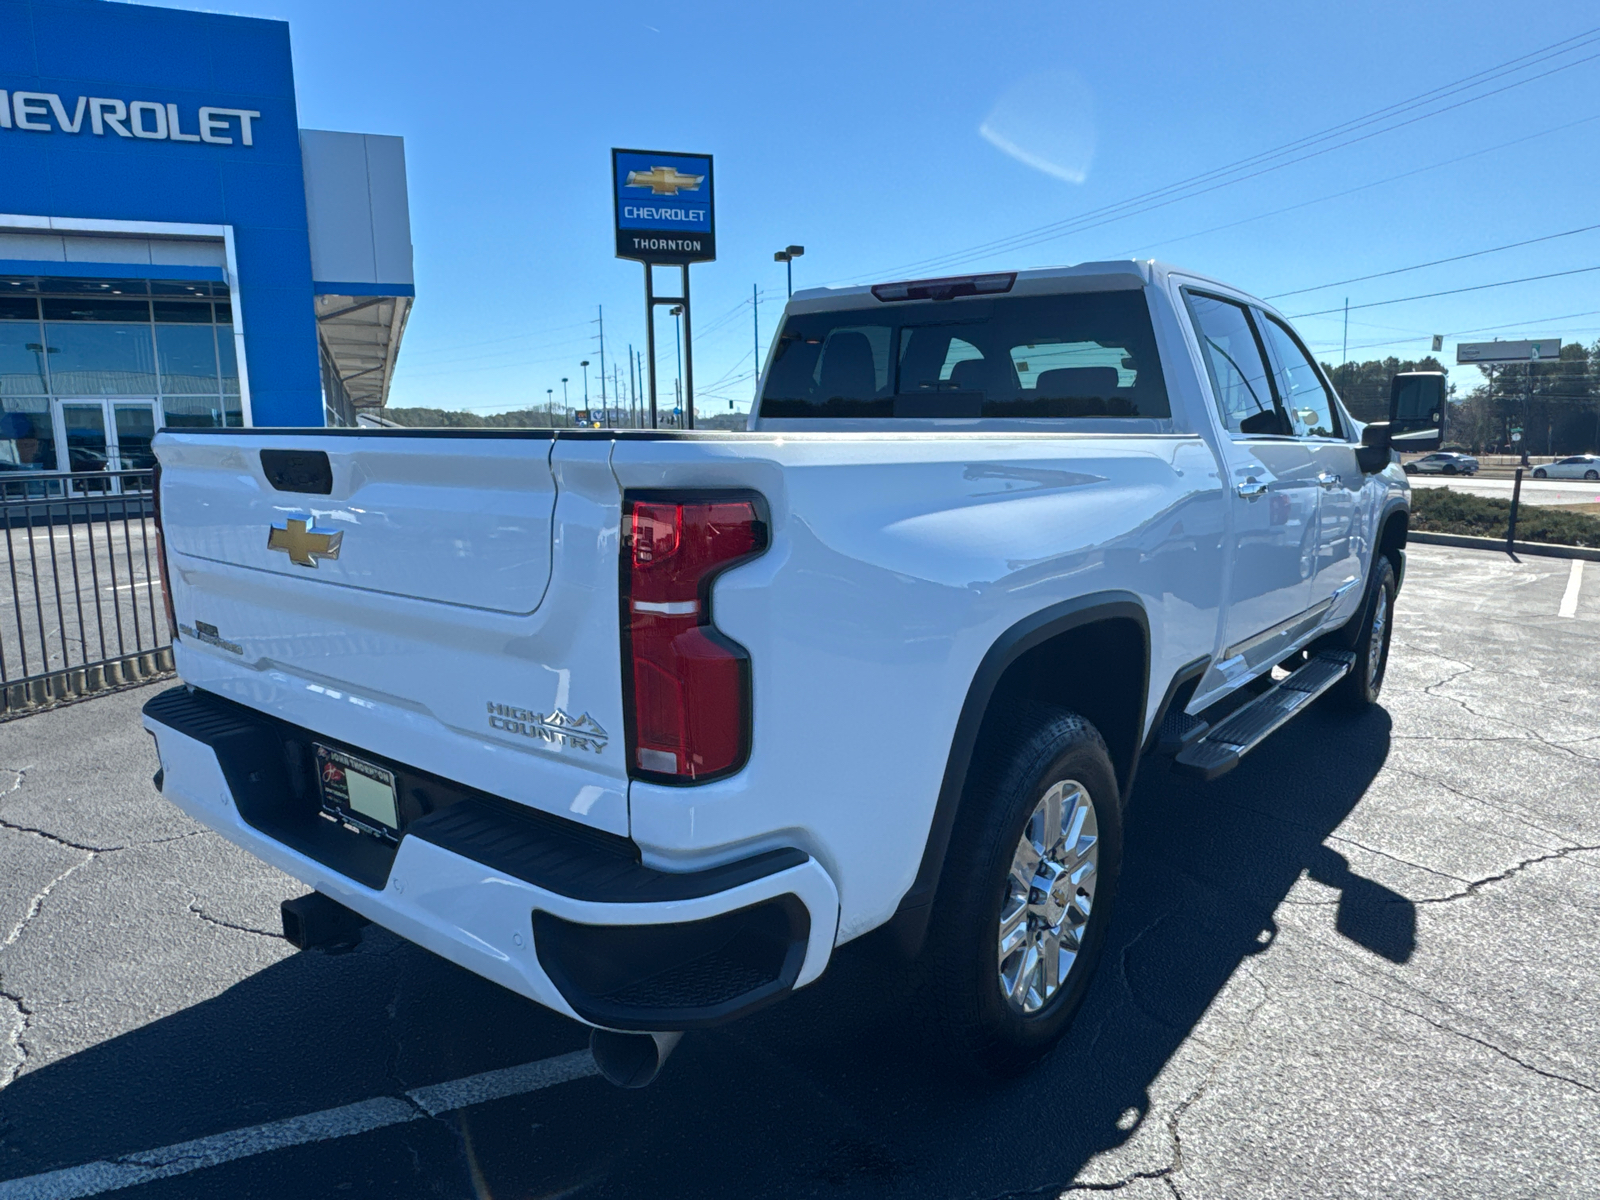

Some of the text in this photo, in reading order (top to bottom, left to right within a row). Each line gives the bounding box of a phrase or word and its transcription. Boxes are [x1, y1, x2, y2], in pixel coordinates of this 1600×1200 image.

[624, 206, 705, 222] CHEVROLET
[633, 238, 701, 251] THORNTON
[486, 700, 545, 725] HIGH
[488, 715, 608, 755] COUNTRY
